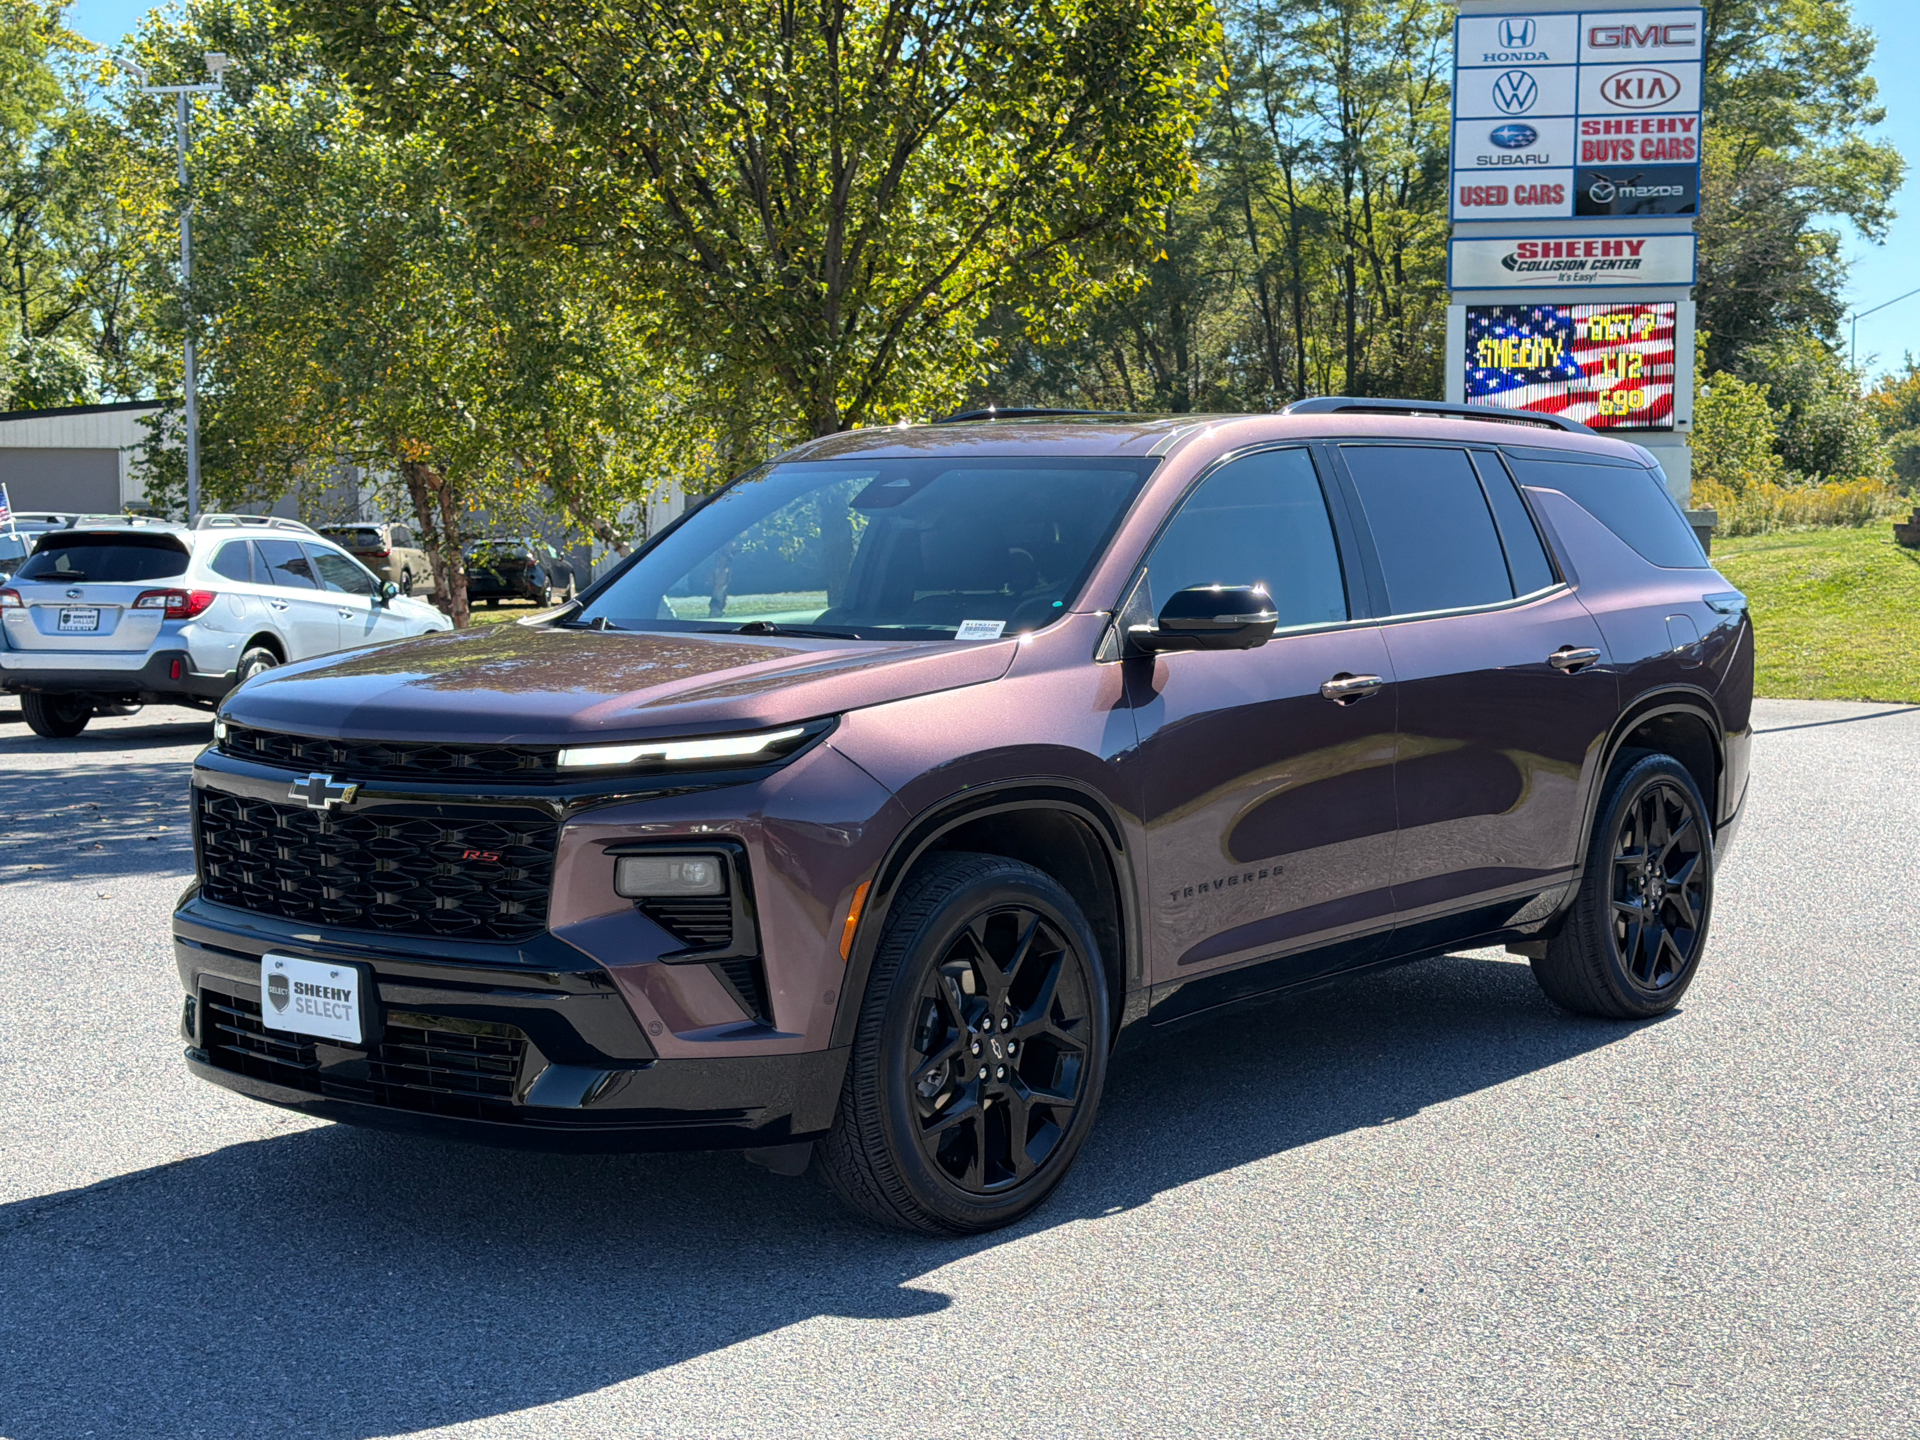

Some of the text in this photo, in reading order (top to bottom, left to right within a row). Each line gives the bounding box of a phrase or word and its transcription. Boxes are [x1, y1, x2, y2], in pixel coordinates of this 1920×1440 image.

[1587, 22, 1696, 49] GMC
[1482, 51, 1550, 63] HONDA
[1614, 78, 1667, 100] KIA
[1581, 118, 1697, 136] SHEEHY
[1581, 137, 1696, 163] BUYS CARS
[1476, 154, 1550, 166] SUBARU
[1460, 184, 1565, 207] USED CARS
[1618, 184, 1684, 198] mazda
[1516, 239, 1647, 259] SHEEHY
[1516, 258, 1643, 272] COLLISION CENTER
[1558, 271, 1598, 283] It's Easy!
[462, 849, 501, 862] RS
[1170, 865, 1284, 902] TRAVERSE
[268, 986, 289, 996] SELECT
[294, 981, 352, 1003] SHEEHY
[295, 997, 353, 1021] SELECT
